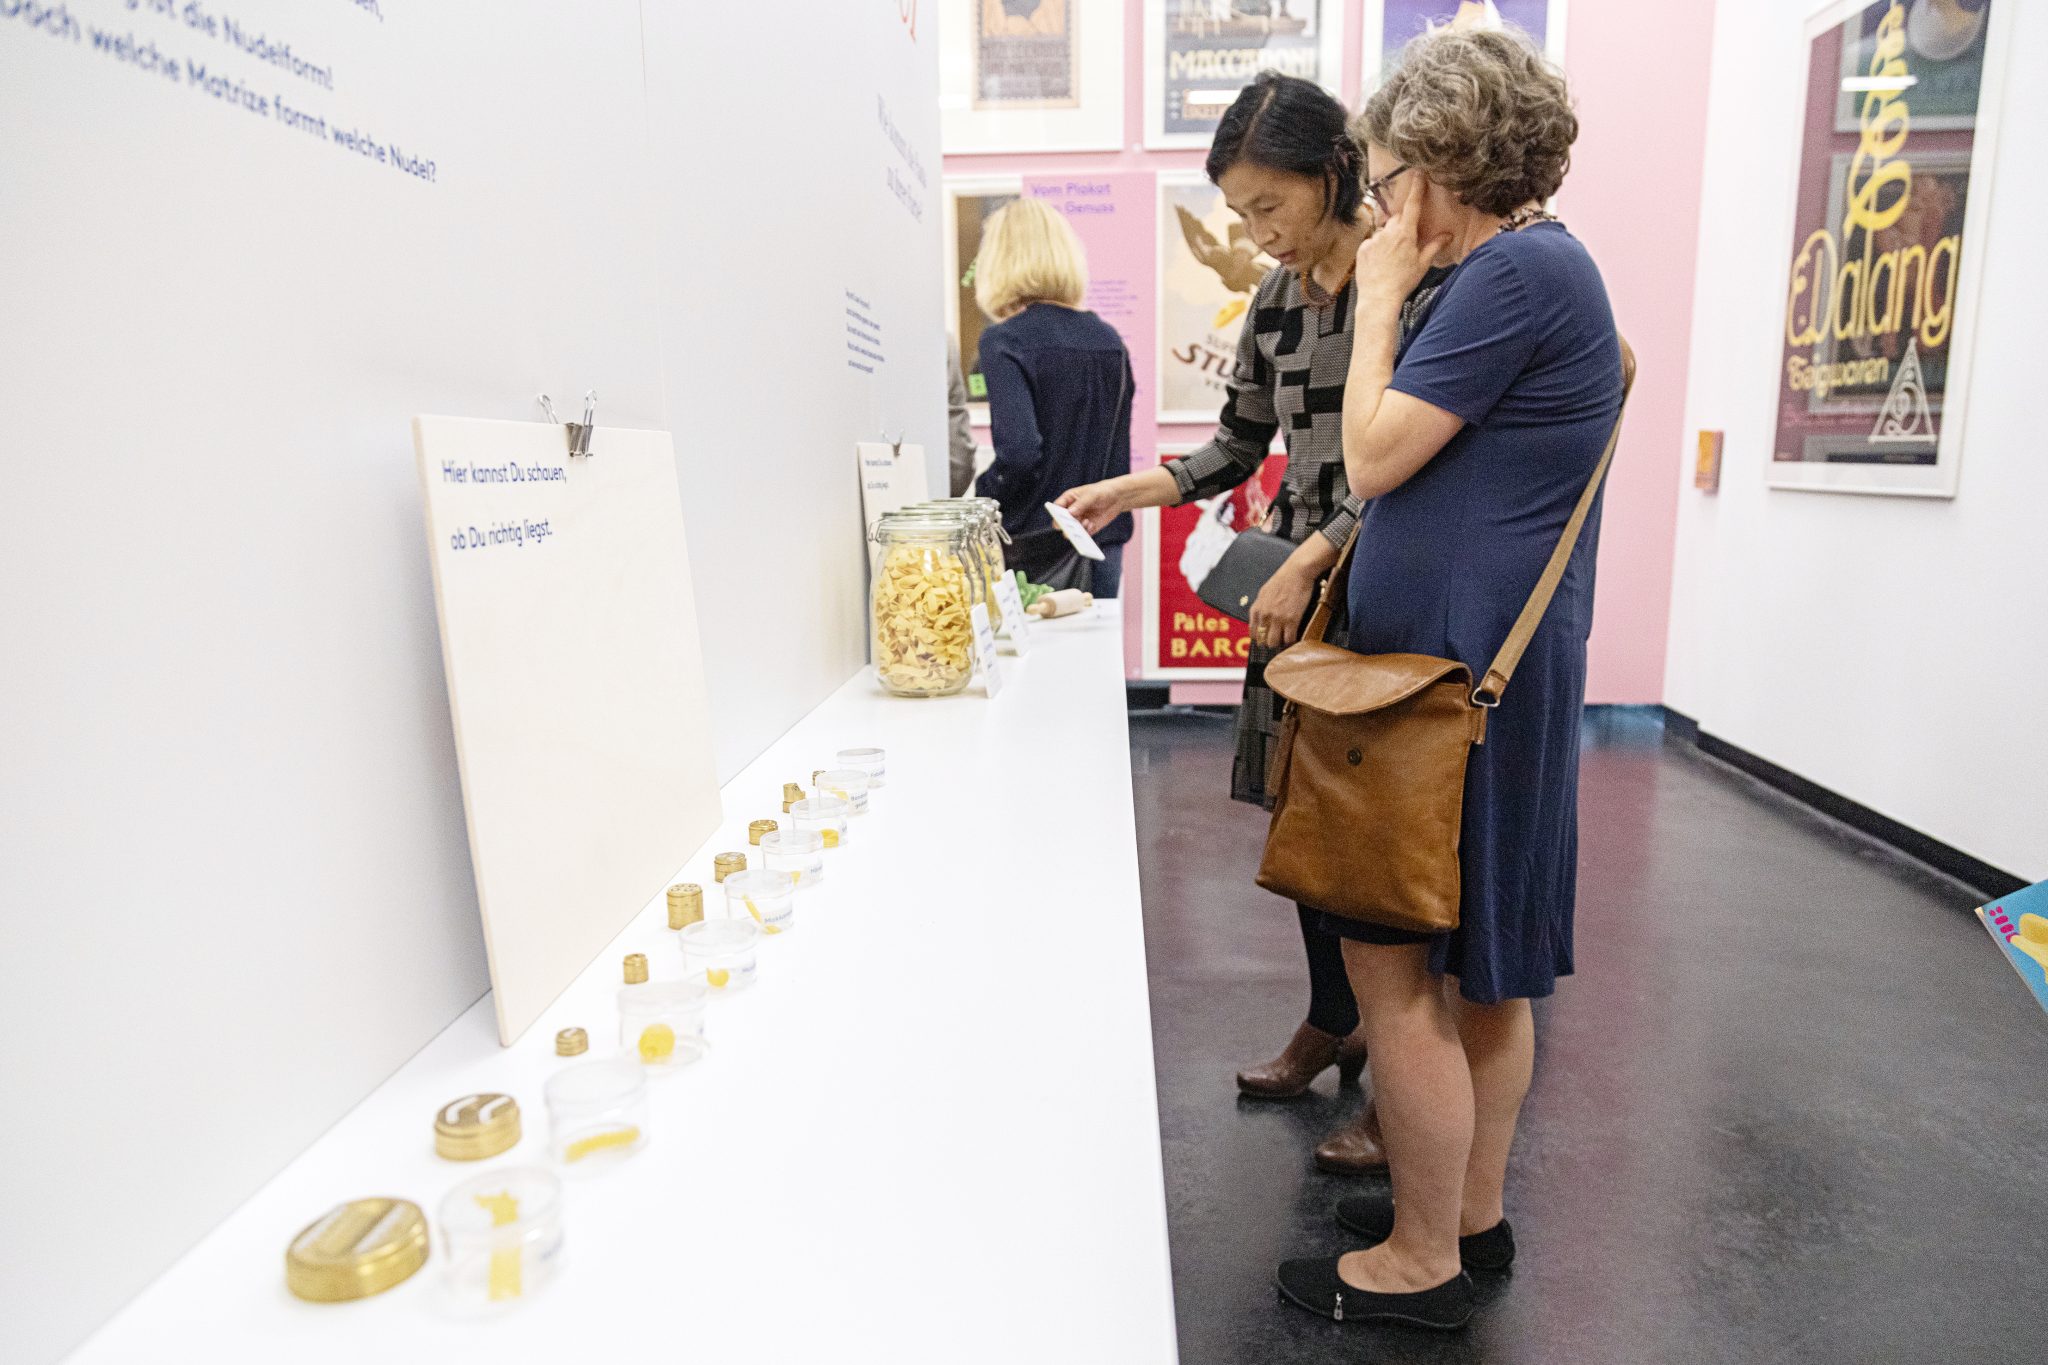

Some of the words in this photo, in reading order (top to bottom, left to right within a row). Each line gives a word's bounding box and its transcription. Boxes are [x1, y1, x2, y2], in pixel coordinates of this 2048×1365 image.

[183, 0, 217, 38] die
[88, 25, 181, 82] welche
[186, 57, 269, 118] Matrize
[273, 94, 328, 141] formt
[331, 124, 387, 164] welche
[390, 143, 437, 184] Nudel?
[442, 459, 468, 483] Hier
[471, 461, 508, 483] kannst
[510, 462, 525, 482] Du
[527, 461, 567, 484] schauen,
[469, 527, 486, 548] Du
[489, 521, 523, 547] richtig
[524, 518, 552, 543] liegst.
